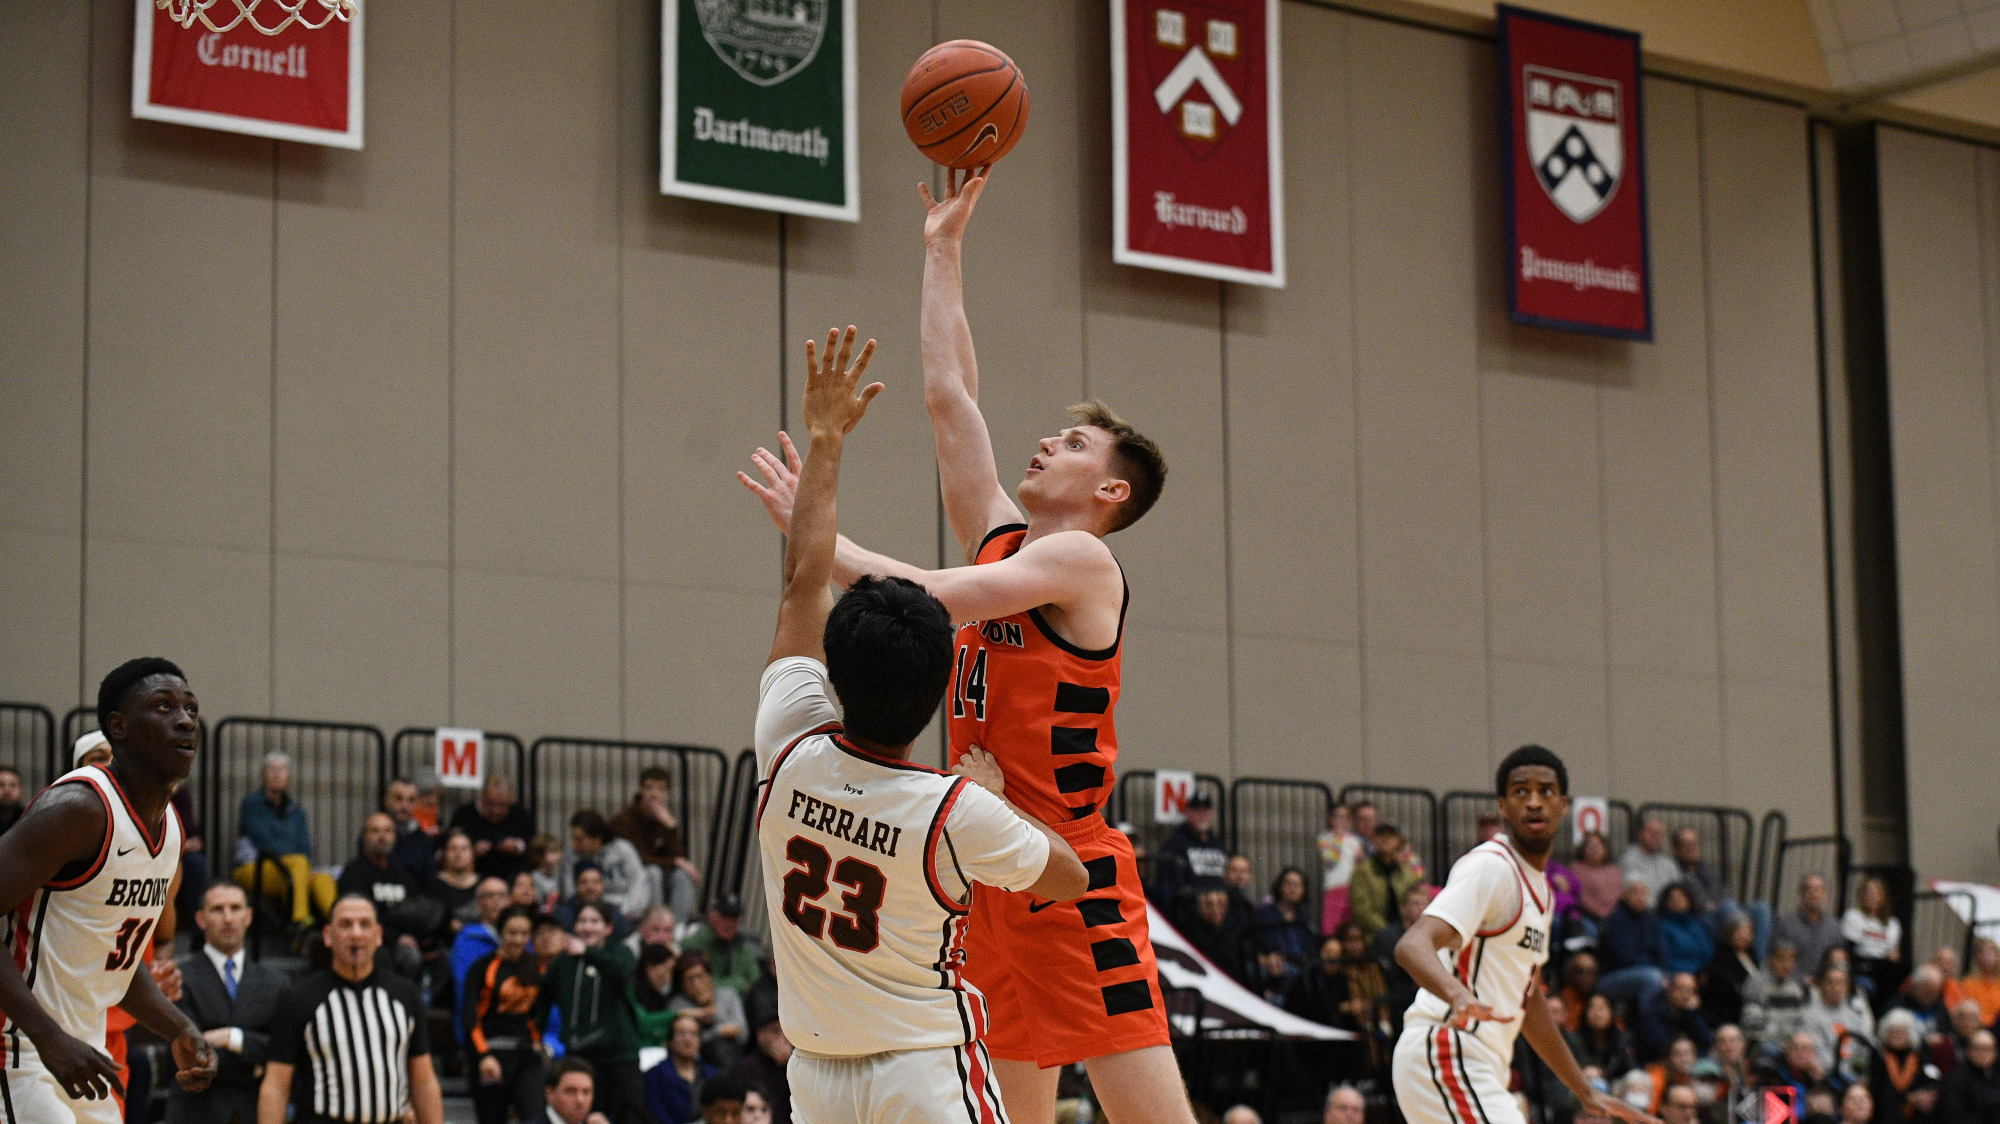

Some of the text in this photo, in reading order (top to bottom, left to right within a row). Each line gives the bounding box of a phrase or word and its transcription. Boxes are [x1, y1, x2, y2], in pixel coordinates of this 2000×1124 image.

[197, 32, 307, 79] Cornell
[693, 106, 829, 167] Dartmouth
[1154, 191, 1248, 235] Harvard
[1520, 245, 1641, 293] Pennsylvania
[953, 645, 987, 722] 14
[442, 739, 477, 777] M
[843, 784, 857, 795] Ivy
[1162, 780, 1188, 815] N
[787, 789, 902, 858] FERRARI
[782, 834, 888, 954] 23
[104, 917, 155, 972] 31
